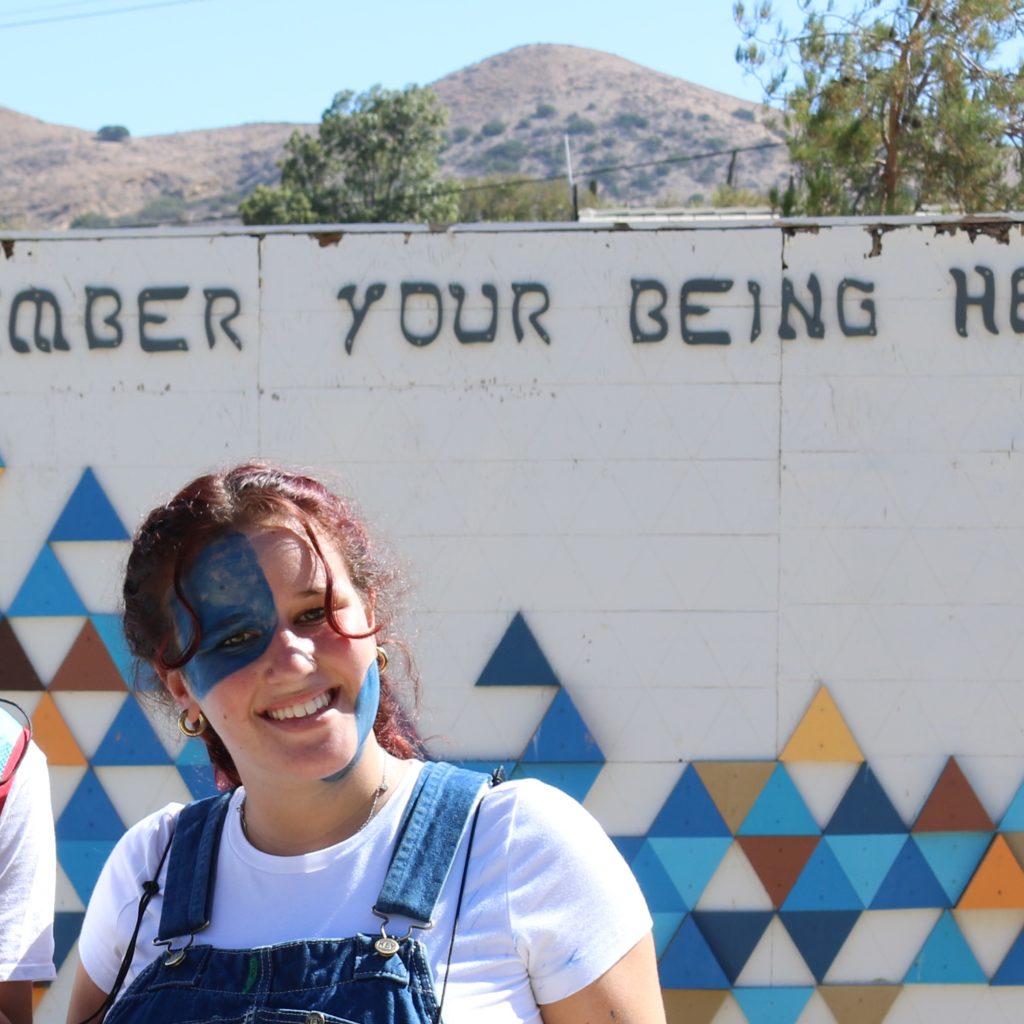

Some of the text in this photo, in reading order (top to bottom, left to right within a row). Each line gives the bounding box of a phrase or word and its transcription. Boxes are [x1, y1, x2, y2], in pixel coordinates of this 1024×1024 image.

[336, 281, 551, 355] YOUR
[629, 273, 878, 345] BEING
[949, 265, 1024, 338] H
